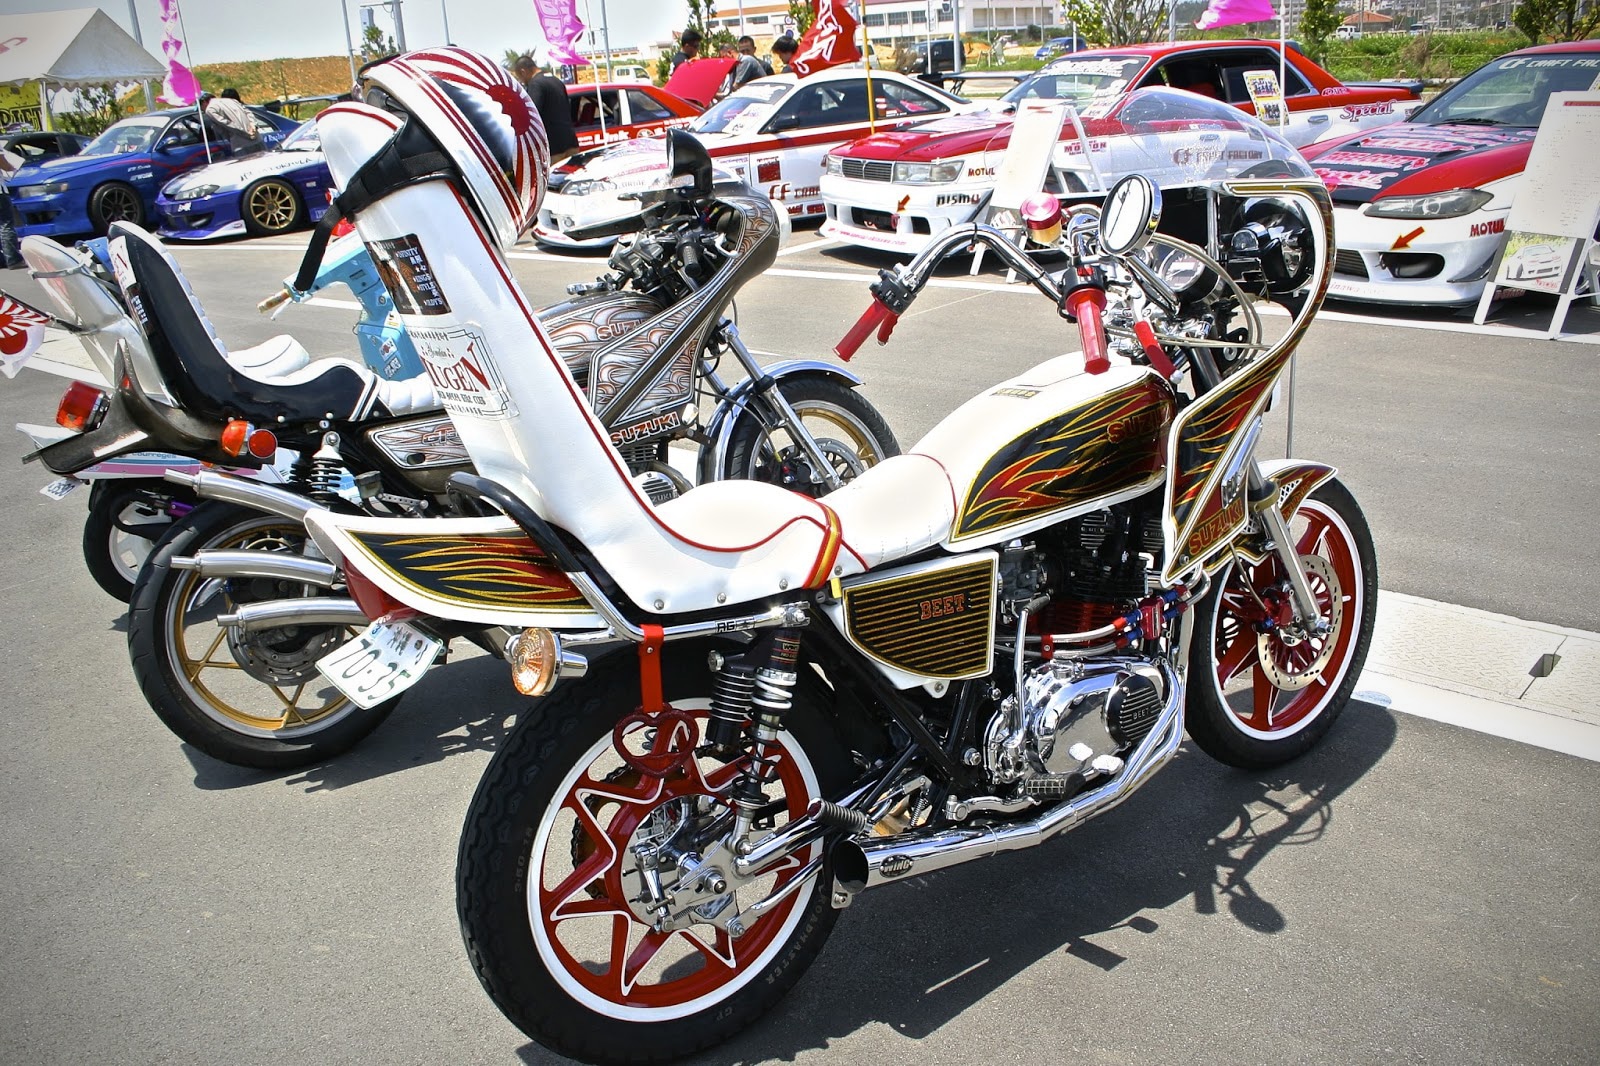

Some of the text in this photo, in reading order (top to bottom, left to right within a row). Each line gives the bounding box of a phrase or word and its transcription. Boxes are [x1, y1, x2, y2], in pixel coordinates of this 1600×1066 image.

[1339, 99, 1397, 122] Special
[967, 167, 996, 177] MOTUL
[597, 319, 644, 341] SUZ
[610, 411, 680, 448] SUZUKI
[1188, 499, 1244, 555] SUZUKI
[920, 593, 965, 620] BEET
[1132, 708, 1149, 720] BEET
